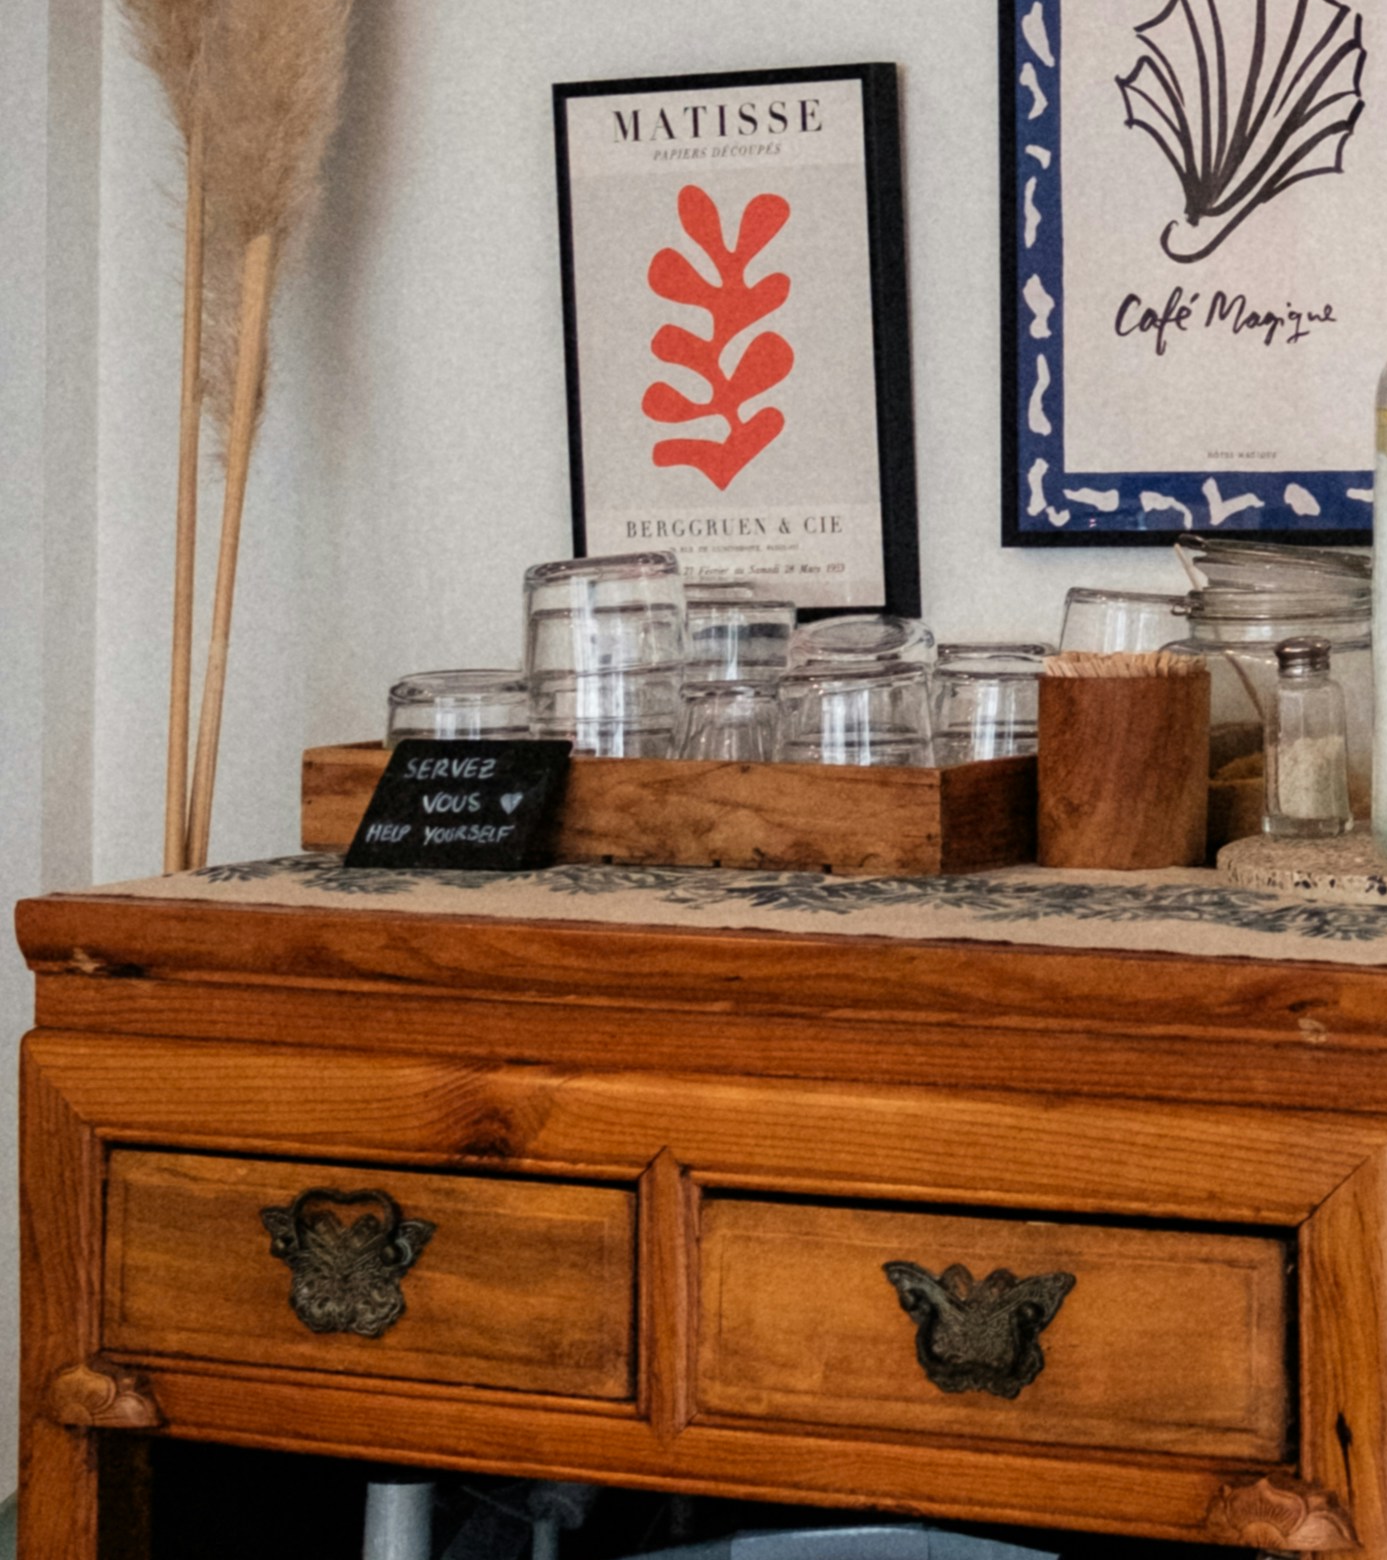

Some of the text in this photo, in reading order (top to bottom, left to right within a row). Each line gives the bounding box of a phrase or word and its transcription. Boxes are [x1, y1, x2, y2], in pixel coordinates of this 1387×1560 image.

[612, 99, 824, 144] MATISSE
[653, 142, 782, 161] PAPIERS DÉCOUPÉS
[1115, 286, 1338, 356] Café Magique
[626, 515, 844, 539] BERGGRUEN & CIE
[403, 757, 497, 780] SERVEZ
[422, 791, 481, 814] VOUS
[365, 824, 516, 846] HELP YOURSELF
